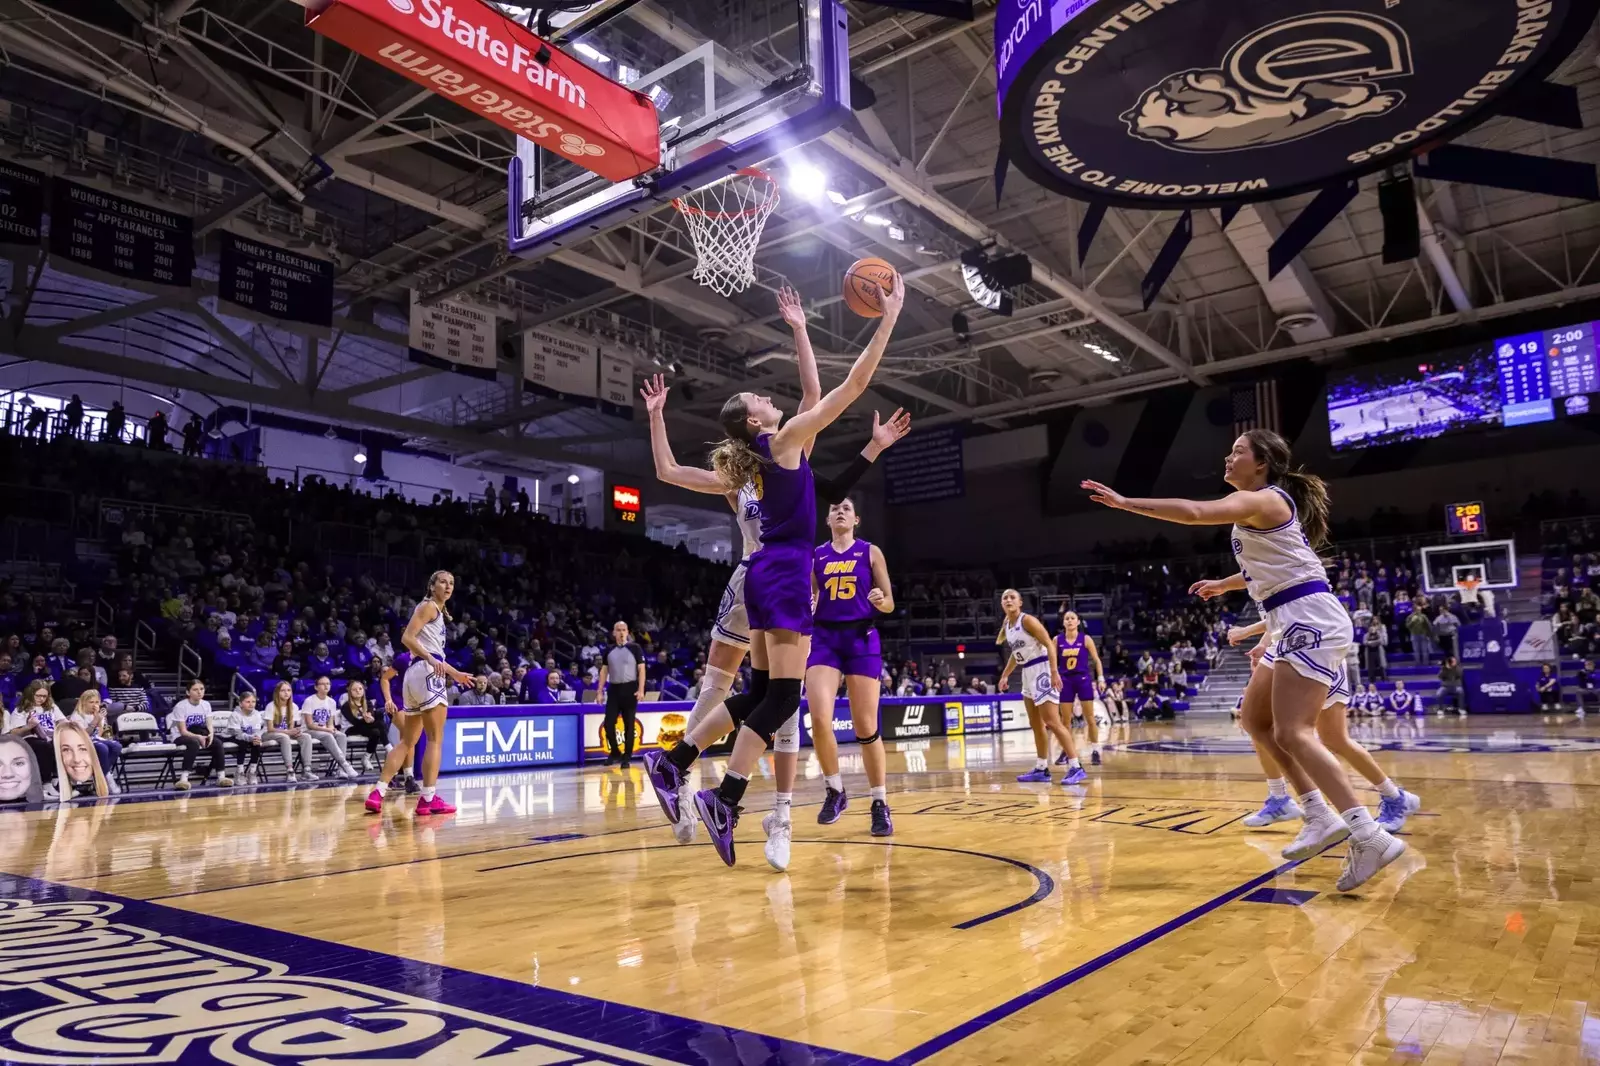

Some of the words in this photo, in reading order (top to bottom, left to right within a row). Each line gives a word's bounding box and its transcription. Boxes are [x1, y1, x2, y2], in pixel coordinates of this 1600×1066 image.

[1065, 0, 1089, 18] FOUL
[1033, 80, 1066, 145] KNAPP
[1347, 69, 1515, 164] BULLDOGS
[1042, 144, 1086, 174] THE
[1080, 170, 1116, 188] TO
[1114, 178, 1269, 196] WELCOME
[70, 187, 119, 211] WOMEN'S
[120, 203, 178, 228] BASKETBALL
[97, 212, 165, 239] APPEARANCES
[234, 240, 272, 260] WOMEN'S
[275, 252, 322, 273] BASKETBALL
[256, 261, 312, 284] APPEARANCES
[1552, 329, 1583, 345] 2:00
[1519, 341, 1538, 355] 19
[1455, 504, 1480, 517] 2:00
[1461, 515, 1479, 531] 16
[823, 560, 857, 575] UNI
[824, 576, 857, 601] 15
[832, 717, 853, 731] nkers
[895, 724, 930, 737] WALDINGER
[455, 719, 554, 755] FMH
[455, 754, 496, 766] FARMERS
[498, 752, 533, 763] MUTUAL
[535, 750, 554, 760] HAIL
